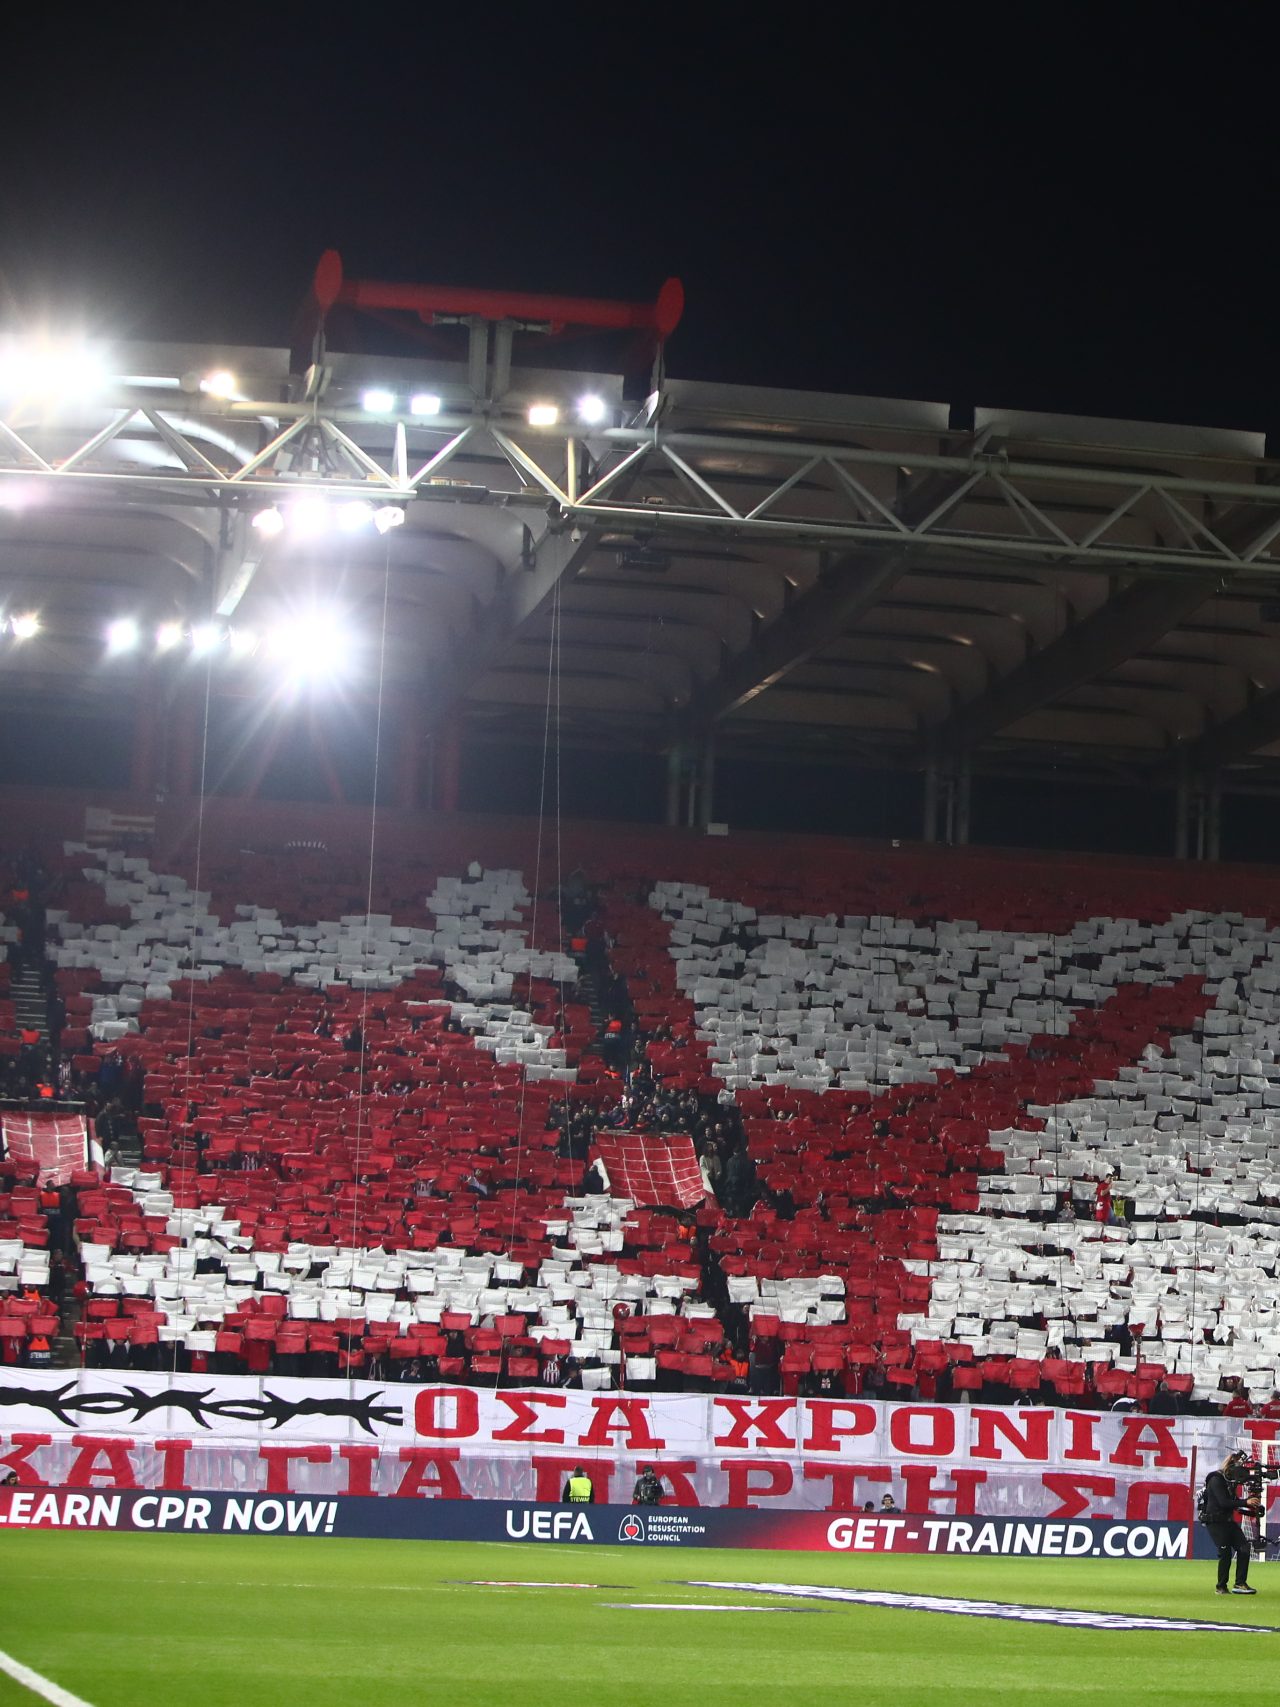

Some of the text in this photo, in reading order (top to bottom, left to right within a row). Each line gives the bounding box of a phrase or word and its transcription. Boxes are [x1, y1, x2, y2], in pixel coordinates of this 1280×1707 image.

[414, 1387, 666, 1450] ΟΣΑ
[713, 1397, 1189, 1469] ΧΡΟΝΙΑ
[257, 1444, 474, 1500] ΓΙΑ
[0, 1492, 338, 1533] EARN CPR NOW!
[506, 1509, 594, 1540] UEFA
[648, 1515, 689, 1525] EUROPEAN
[648, 1524, 706, 1534] RESUSCITATION
[648, 1533, 681, 1542] COUNCIL
[827, 1517, 1189, 1558] GET-TRAINED.COM
